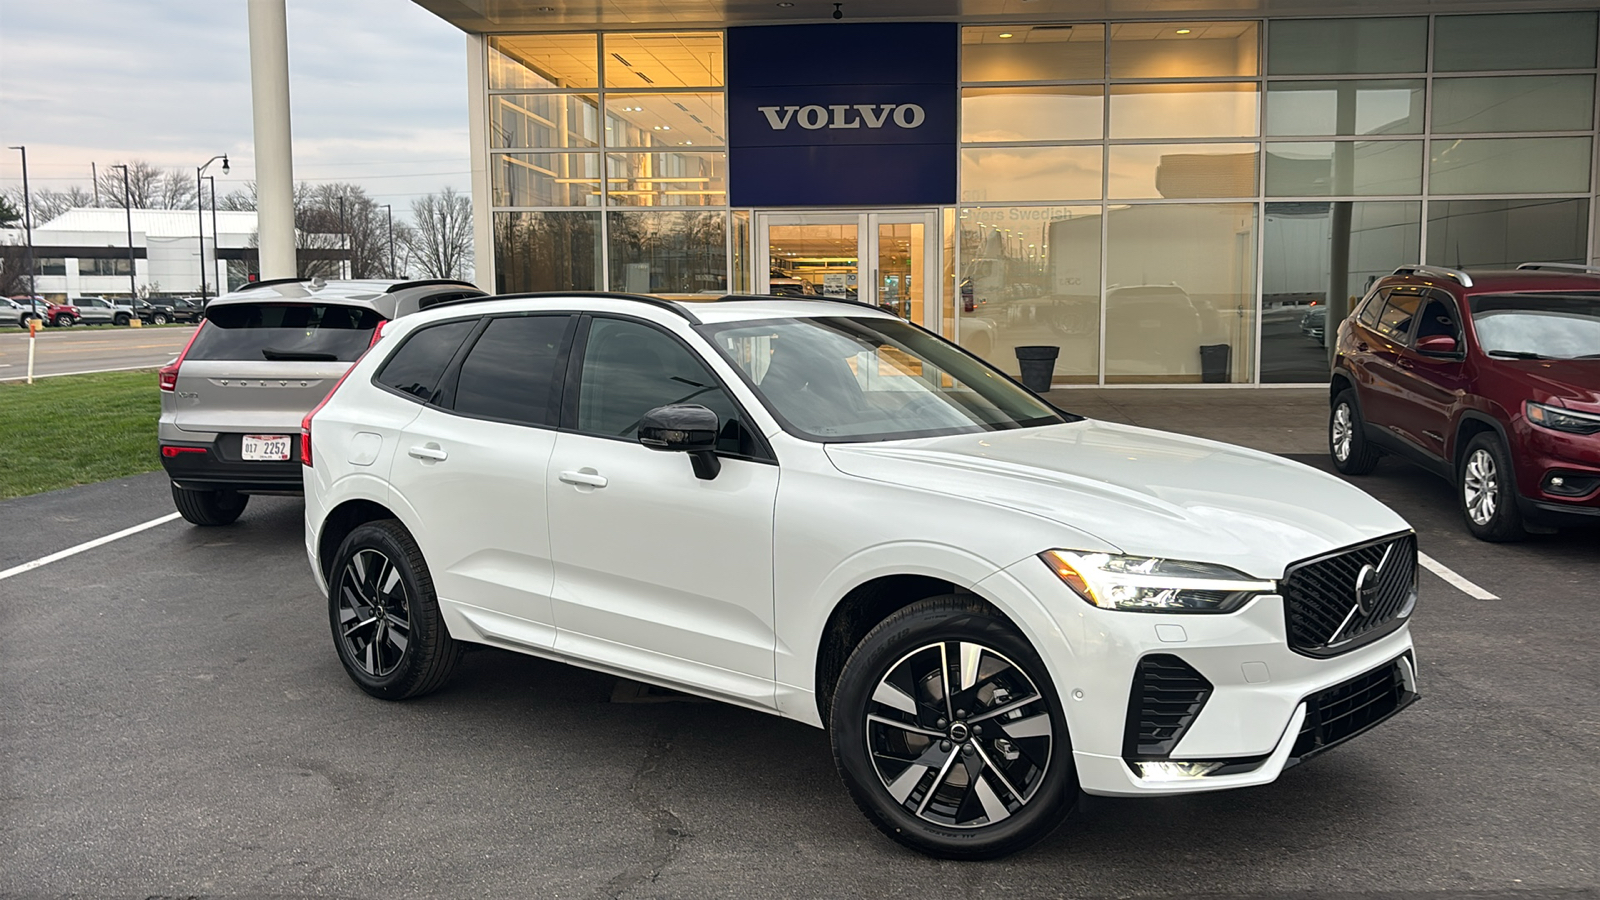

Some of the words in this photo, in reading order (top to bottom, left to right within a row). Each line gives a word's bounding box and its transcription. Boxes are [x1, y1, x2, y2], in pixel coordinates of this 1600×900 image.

[757, 103, 926, 130] VOLVO
[1009, 207, 1073, 220] Swedish
[245, 443, 257, 453] 017
[264, 442, 286, 454] 2252
